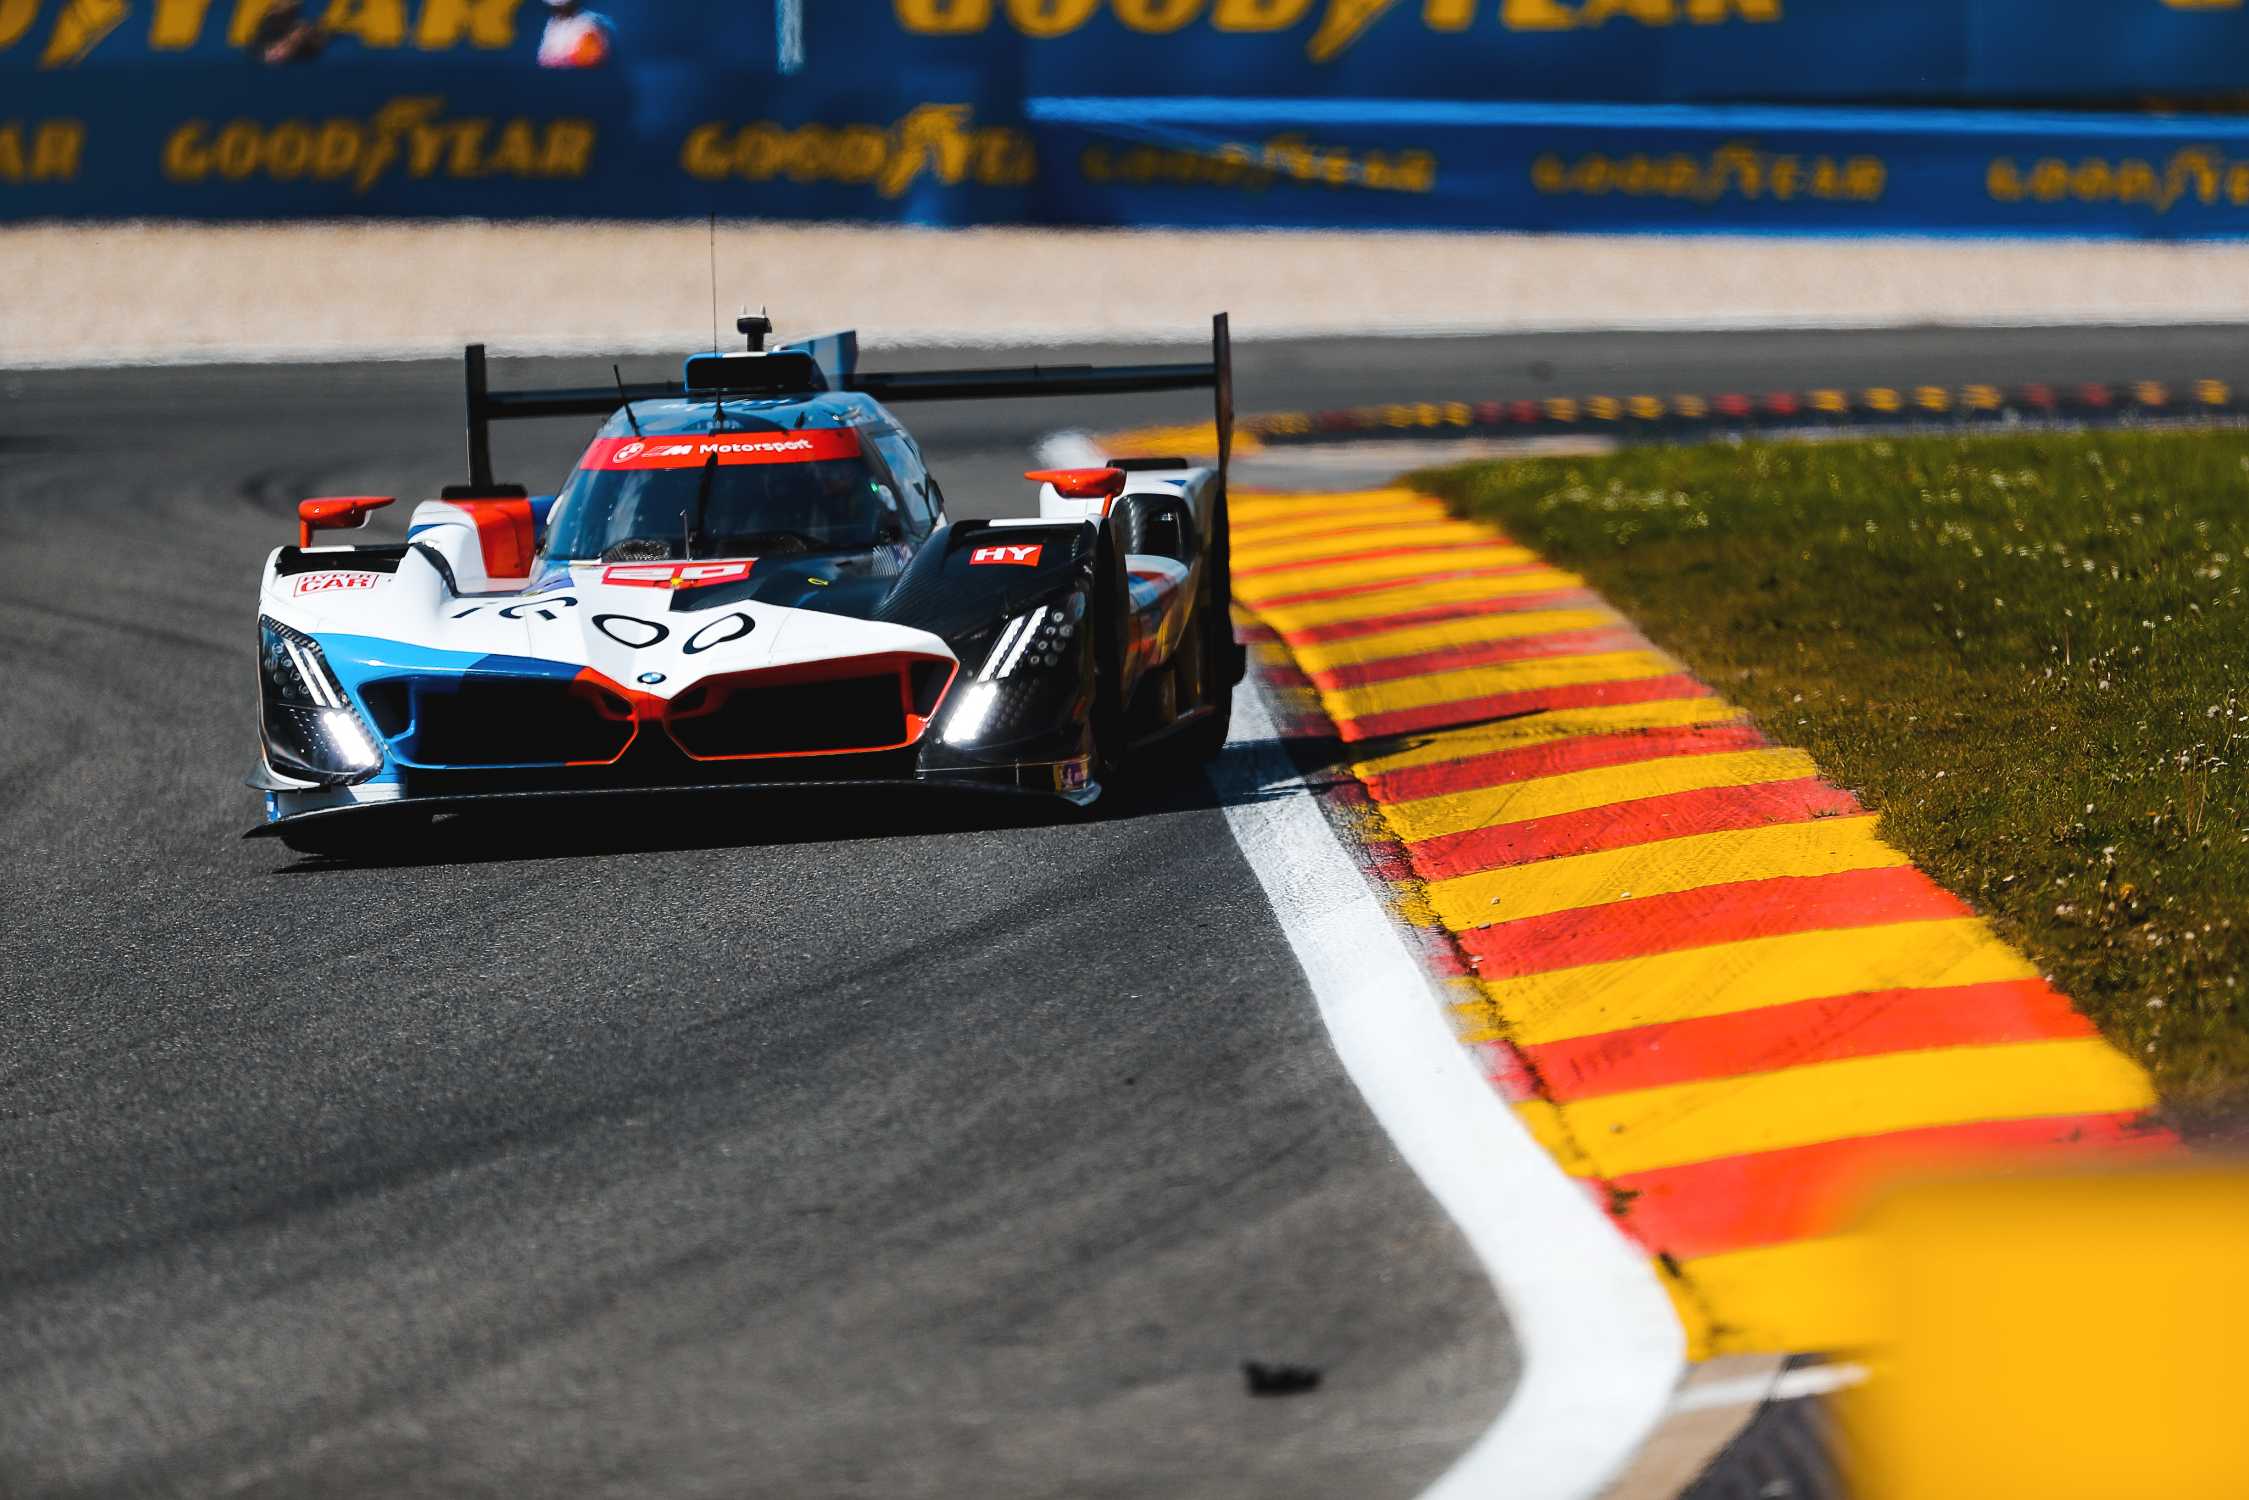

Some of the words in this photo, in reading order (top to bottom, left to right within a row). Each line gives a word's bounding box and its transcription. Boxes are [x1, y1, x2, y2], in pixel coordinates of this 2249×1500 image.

[163, 97, 596, 191] GOODYEAR
[699, 438, 813, 455] Motorsport
[974, 546, 1038, 561] HY
[300, 577, 369, 593] CAR
